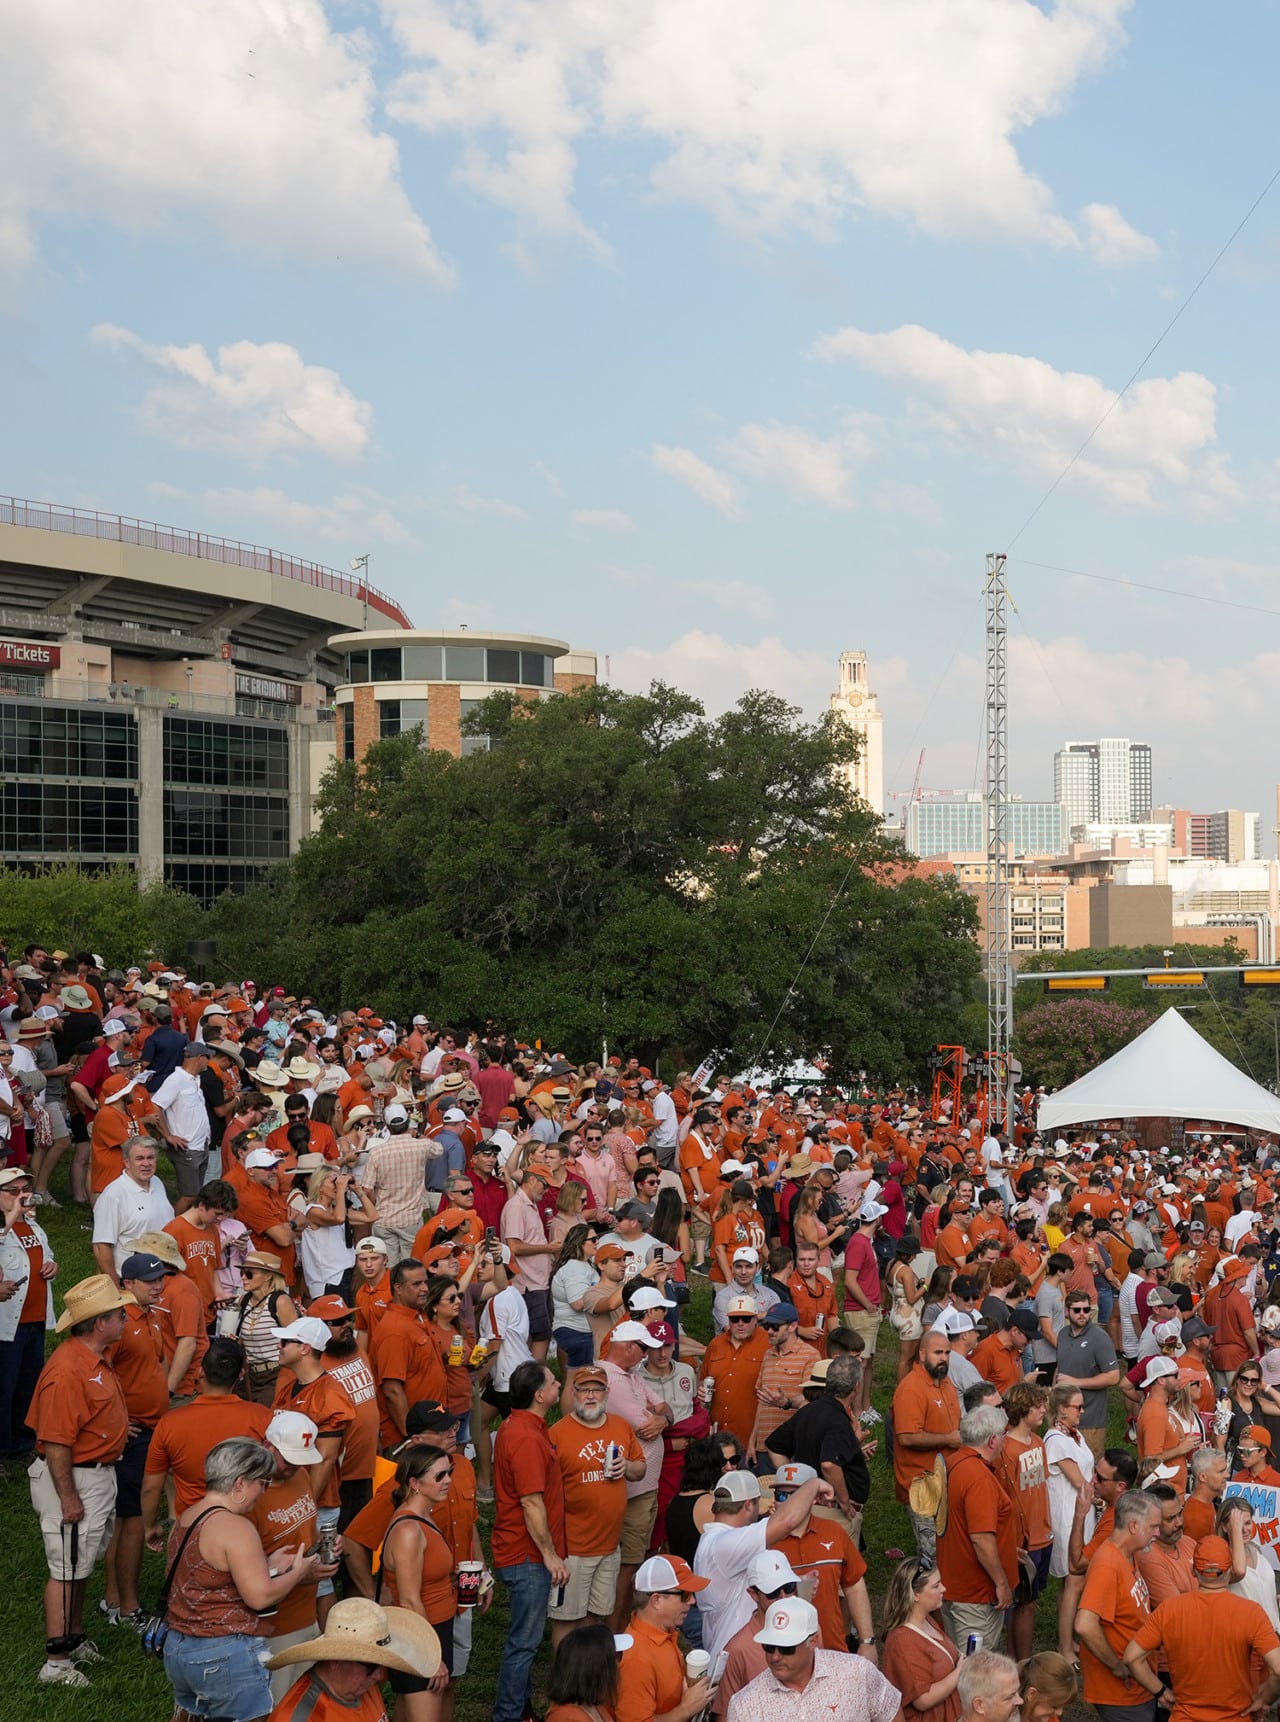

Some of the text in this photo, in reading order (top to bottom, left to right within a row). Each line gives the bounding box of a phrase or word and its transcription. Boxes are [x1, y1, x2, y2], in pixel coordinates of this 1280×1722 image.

[4, 643, 50, 663] Tickets
[236, 675, 250, 693] THE
[251, 678, 287, 700] GRIDIRON
[750, 1228, 766, 1250] 10
[655, 1325, 667, 1337] A
[343, 1369, 372, 1392] UTTA
[302, 1433, 313, 1448] T
[582, 1470, 605, 1483] LONG
[784, 1467, 798, 1481] T
[777, 1616, 785, 1626] T
